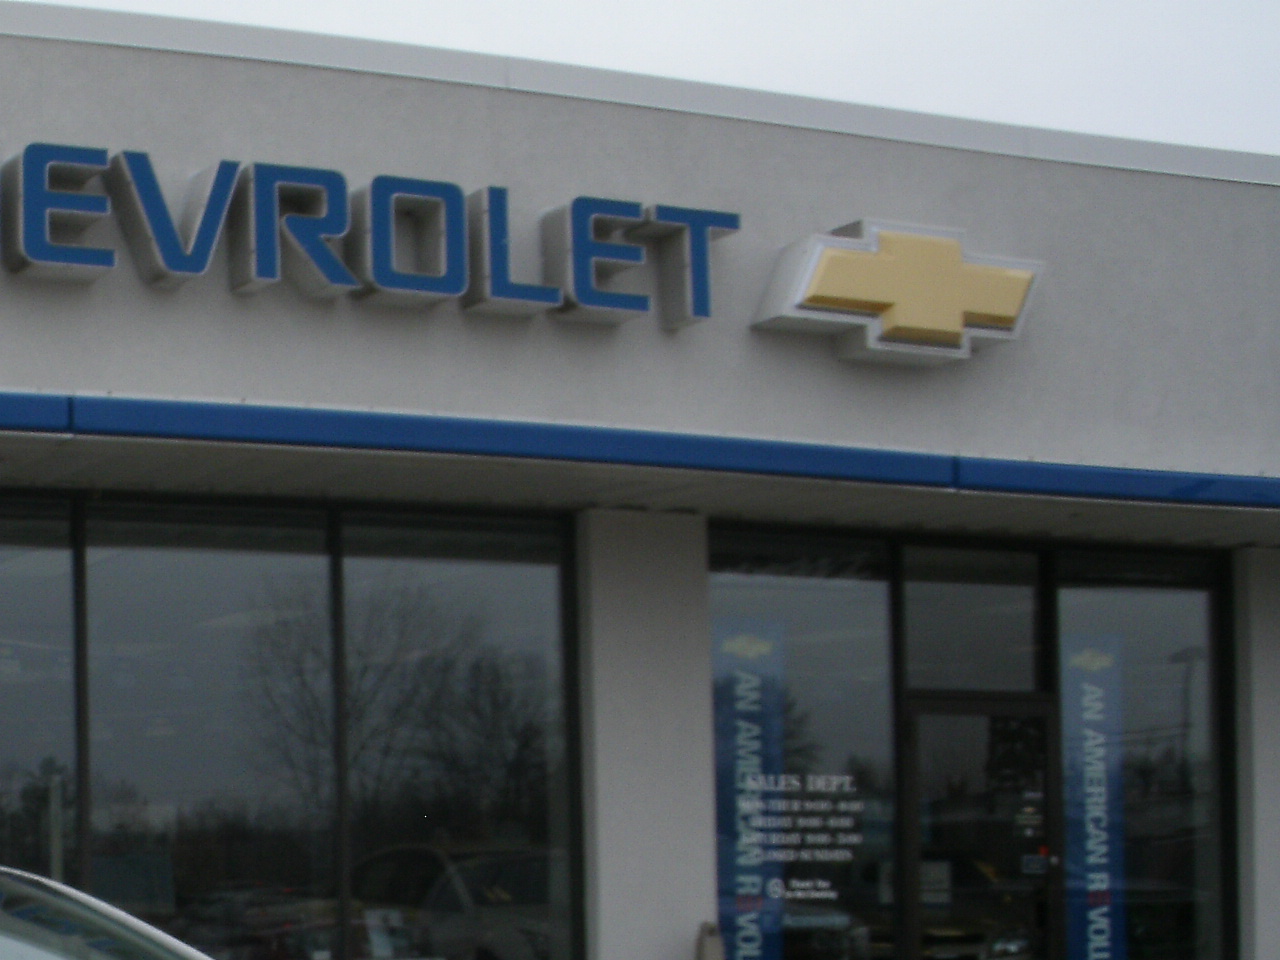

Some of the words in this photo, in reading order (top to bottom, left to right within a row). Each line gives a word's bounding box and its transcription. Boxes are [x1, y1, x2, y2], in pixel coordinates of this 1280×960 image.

[734, 670, 762, 711] AN
[1082, 681, 1105, 721] AN
[746, 774, 801, 791] SALES
[1083, 728, 1110, 865] AMERICAN
